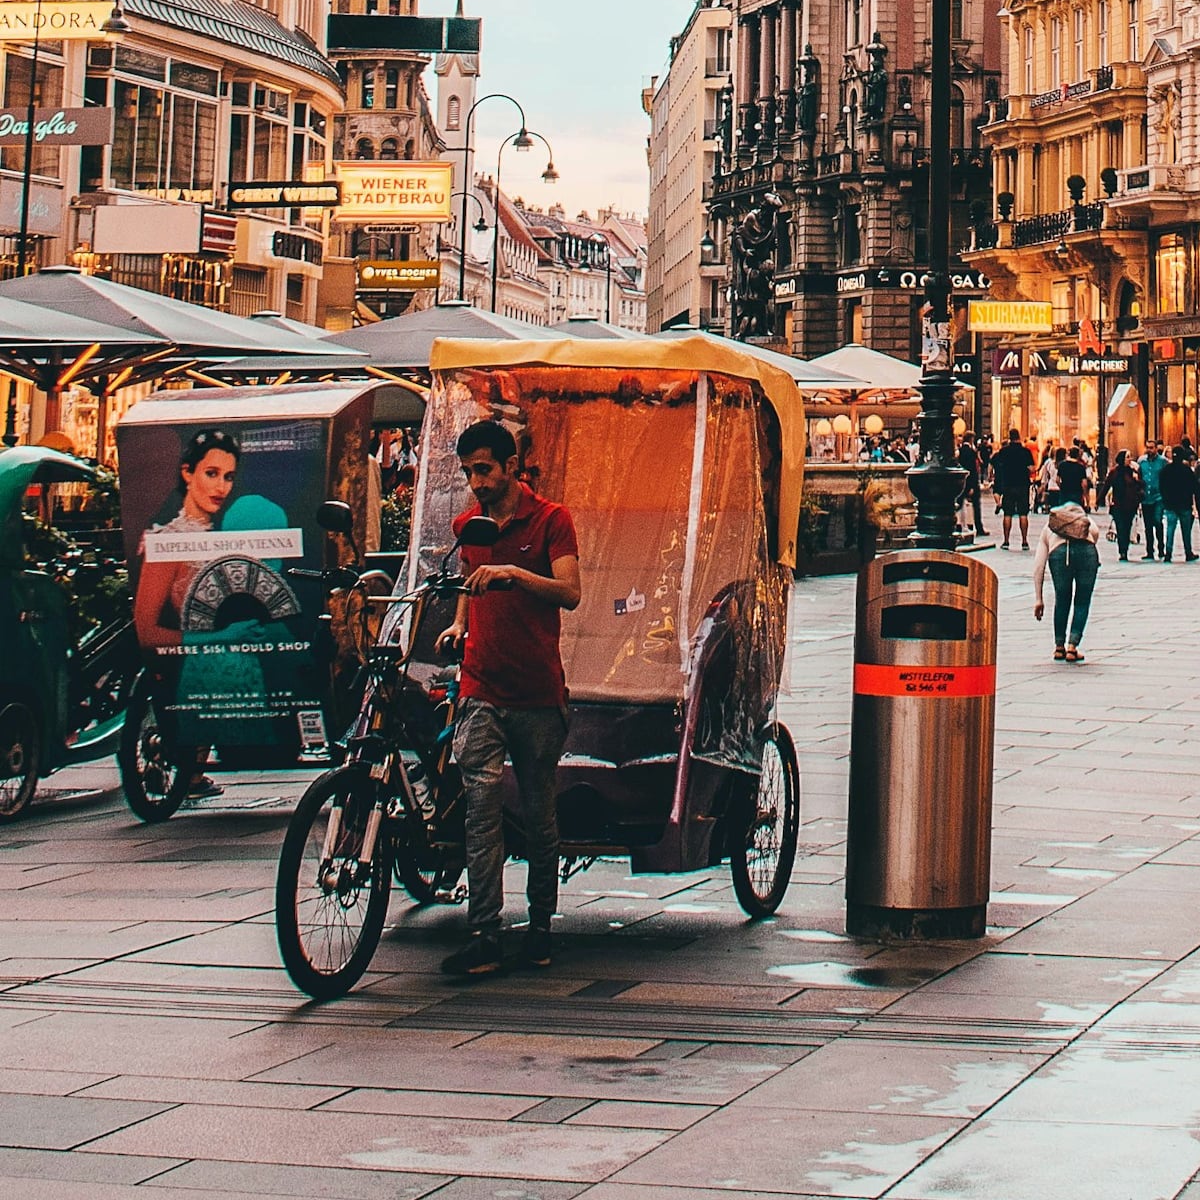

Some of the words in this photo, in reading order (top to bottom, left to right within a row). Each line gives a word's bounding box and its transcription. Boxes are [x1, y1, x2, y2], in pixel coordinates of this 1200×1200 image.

[361, 178, 428, 190] WIENER
[232, 189, 283, 203] GERRY
[284, 187, 338, 202] WEBER
[375, 269, 398, 277] YVES
[400, 269, 438, 277] ROCHER
[844, 277, 859, 290] OMEGA
[920, 275, 974, 288] OGA
[154, 541, 210, 554] IMPERIAL
[213, 539, 246, 551] SHOP
[249, 537, 294, 550] VIENNA
[156, 645, 199, 656] WHERE
[203, 644, 226, 654] SISI
[229, 643, 274, 653] WOULD
[278, 641, 311, 651] SHOP
[899, 672, 955, 682] MISTTELEFON
[918, 684, 934, 692] 546
